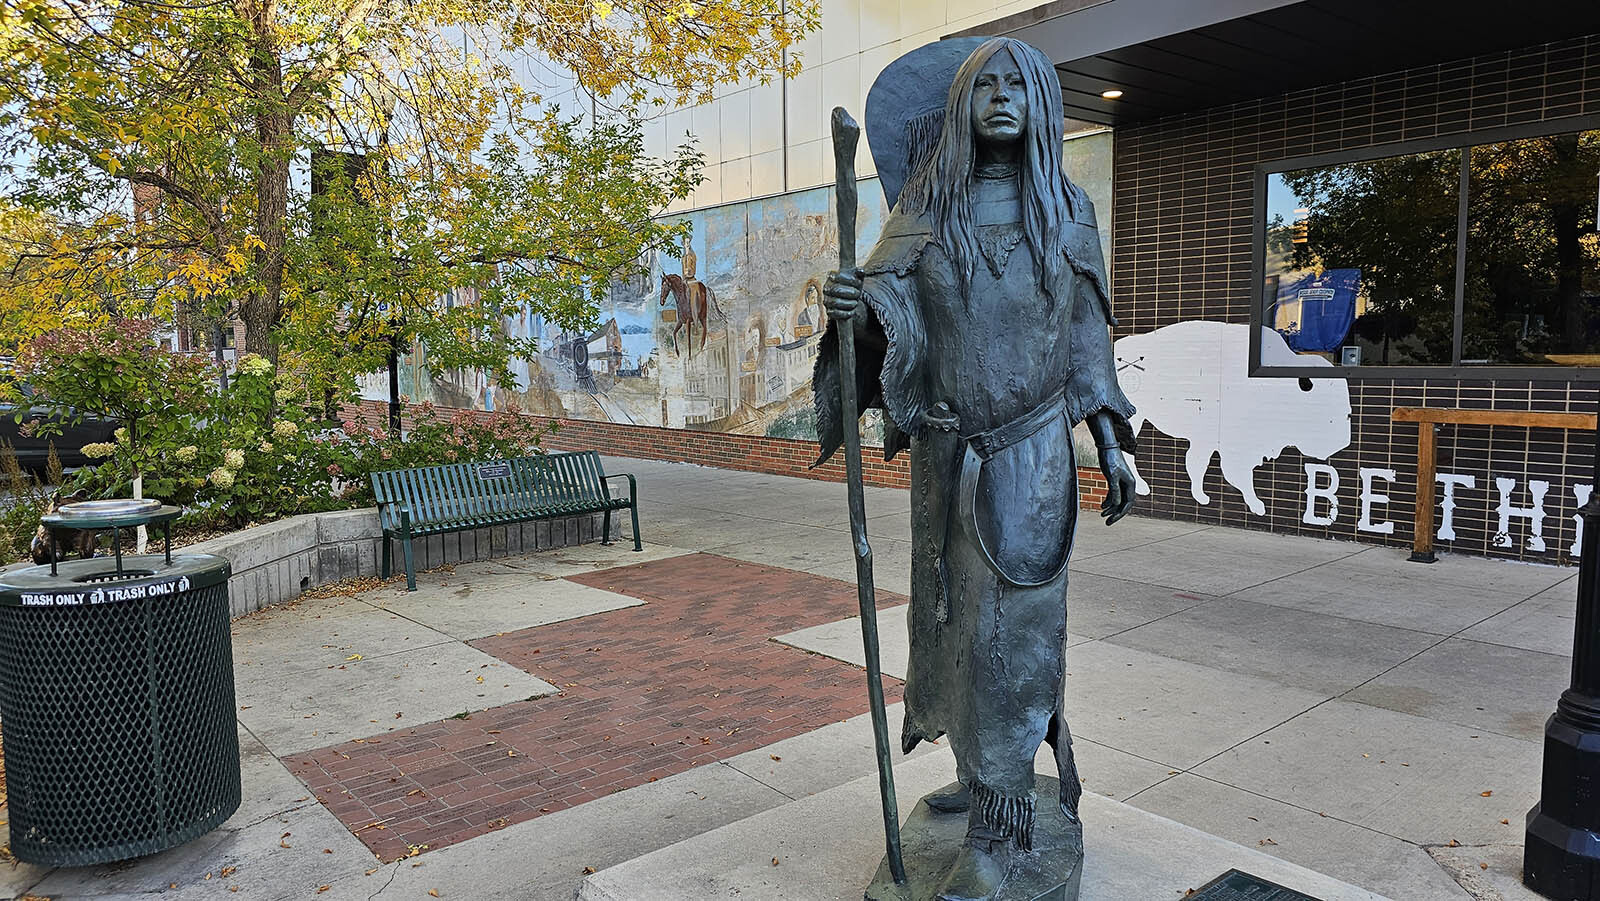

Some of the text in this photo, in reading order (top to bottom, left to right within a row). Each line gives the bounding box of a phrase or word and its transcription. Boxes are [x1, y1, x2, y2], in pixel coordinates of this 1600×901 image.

[21, 581, 176, 606] TRASH ONLY TRASH ONLY
